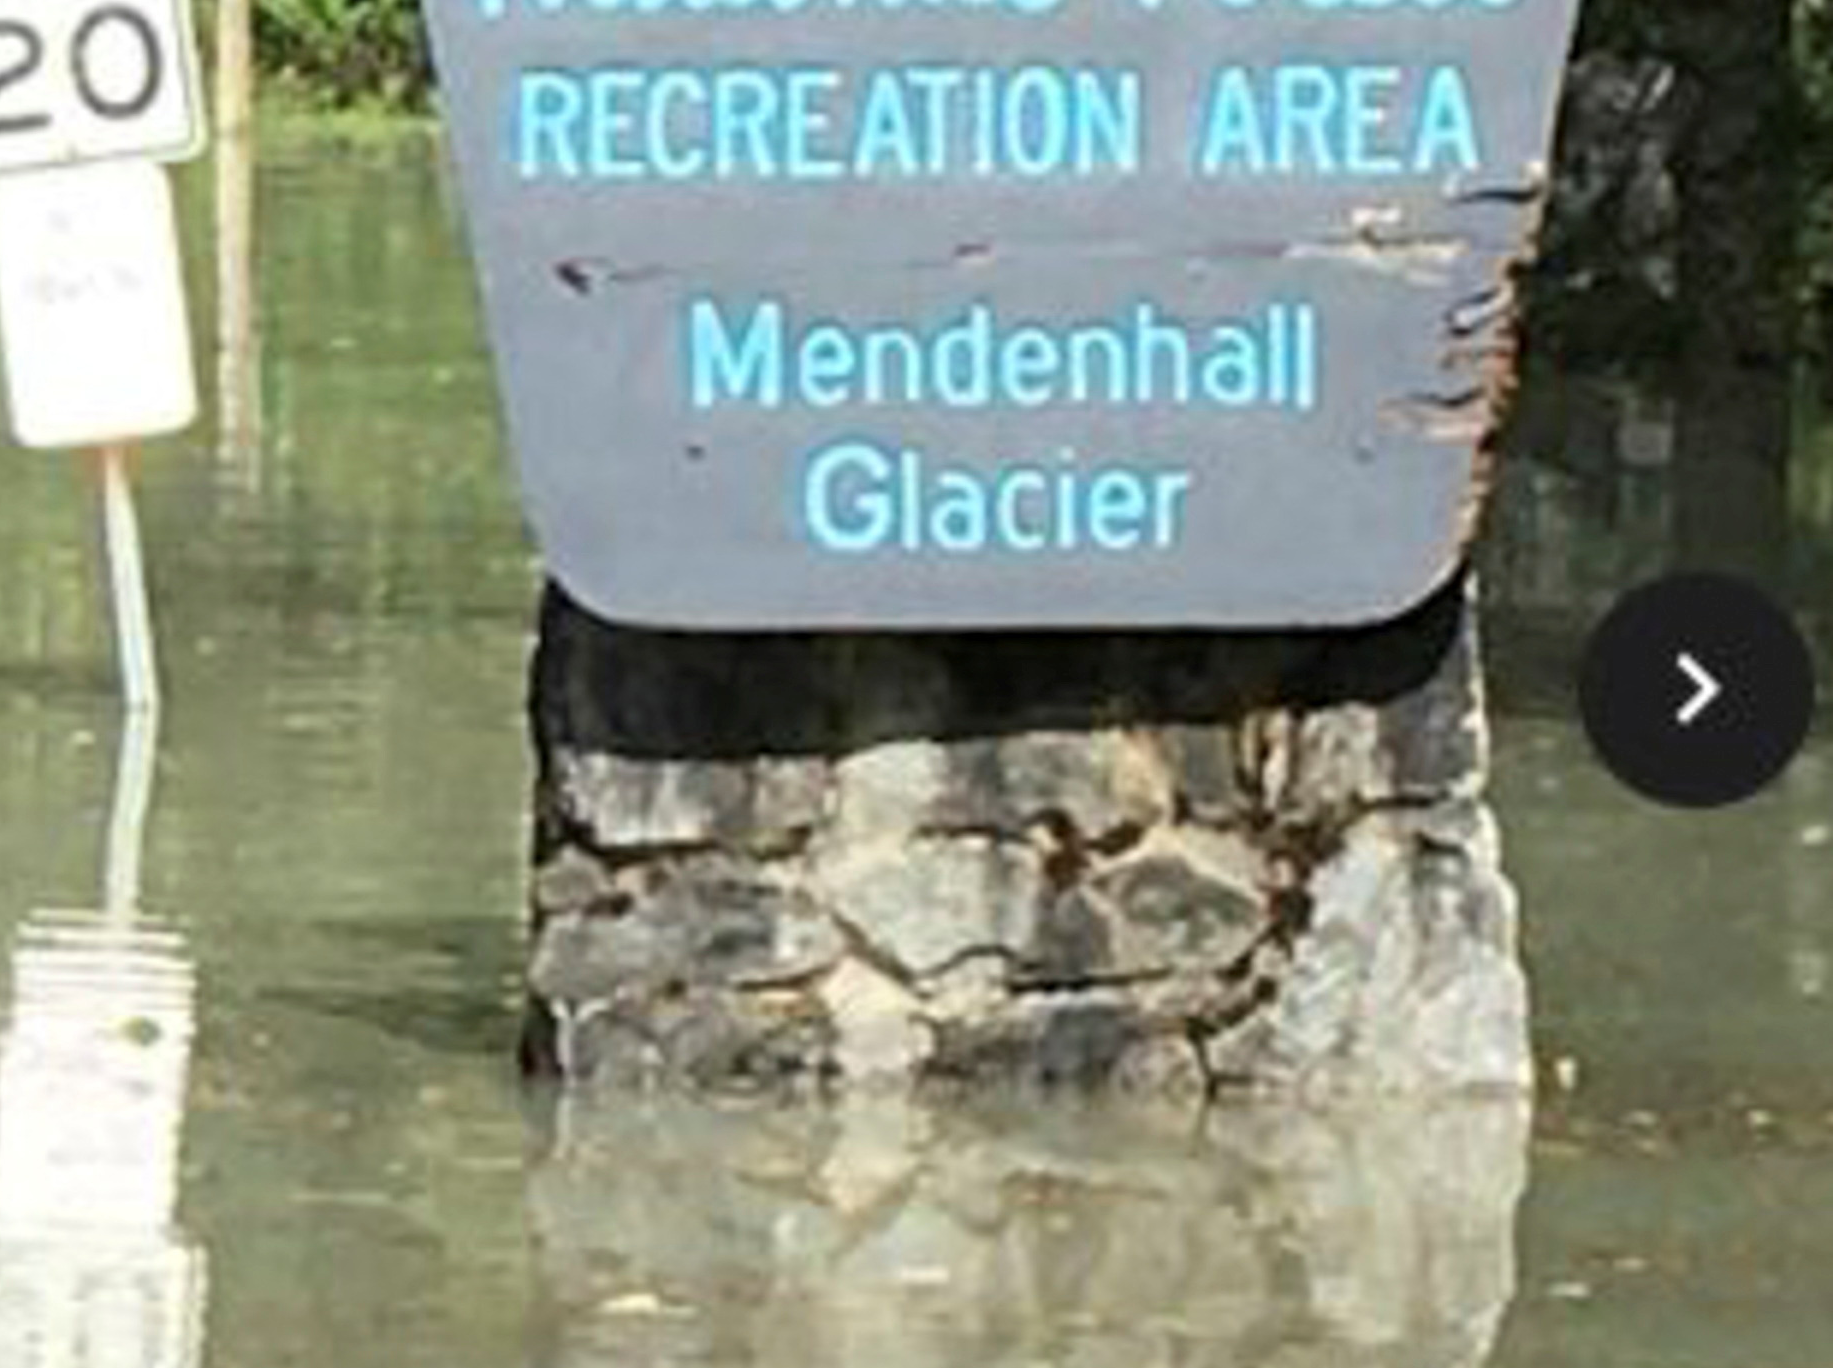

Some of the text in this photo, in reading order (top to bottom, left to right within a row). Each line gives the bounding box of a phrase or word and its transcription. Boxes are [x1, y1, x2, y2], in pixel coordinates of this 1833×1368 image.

[517, 65, 1480, 179] RECREATION AREA
[689, 300, 1315, 409] Mendenhall
[805, 444, 1190, 552] Glacier
